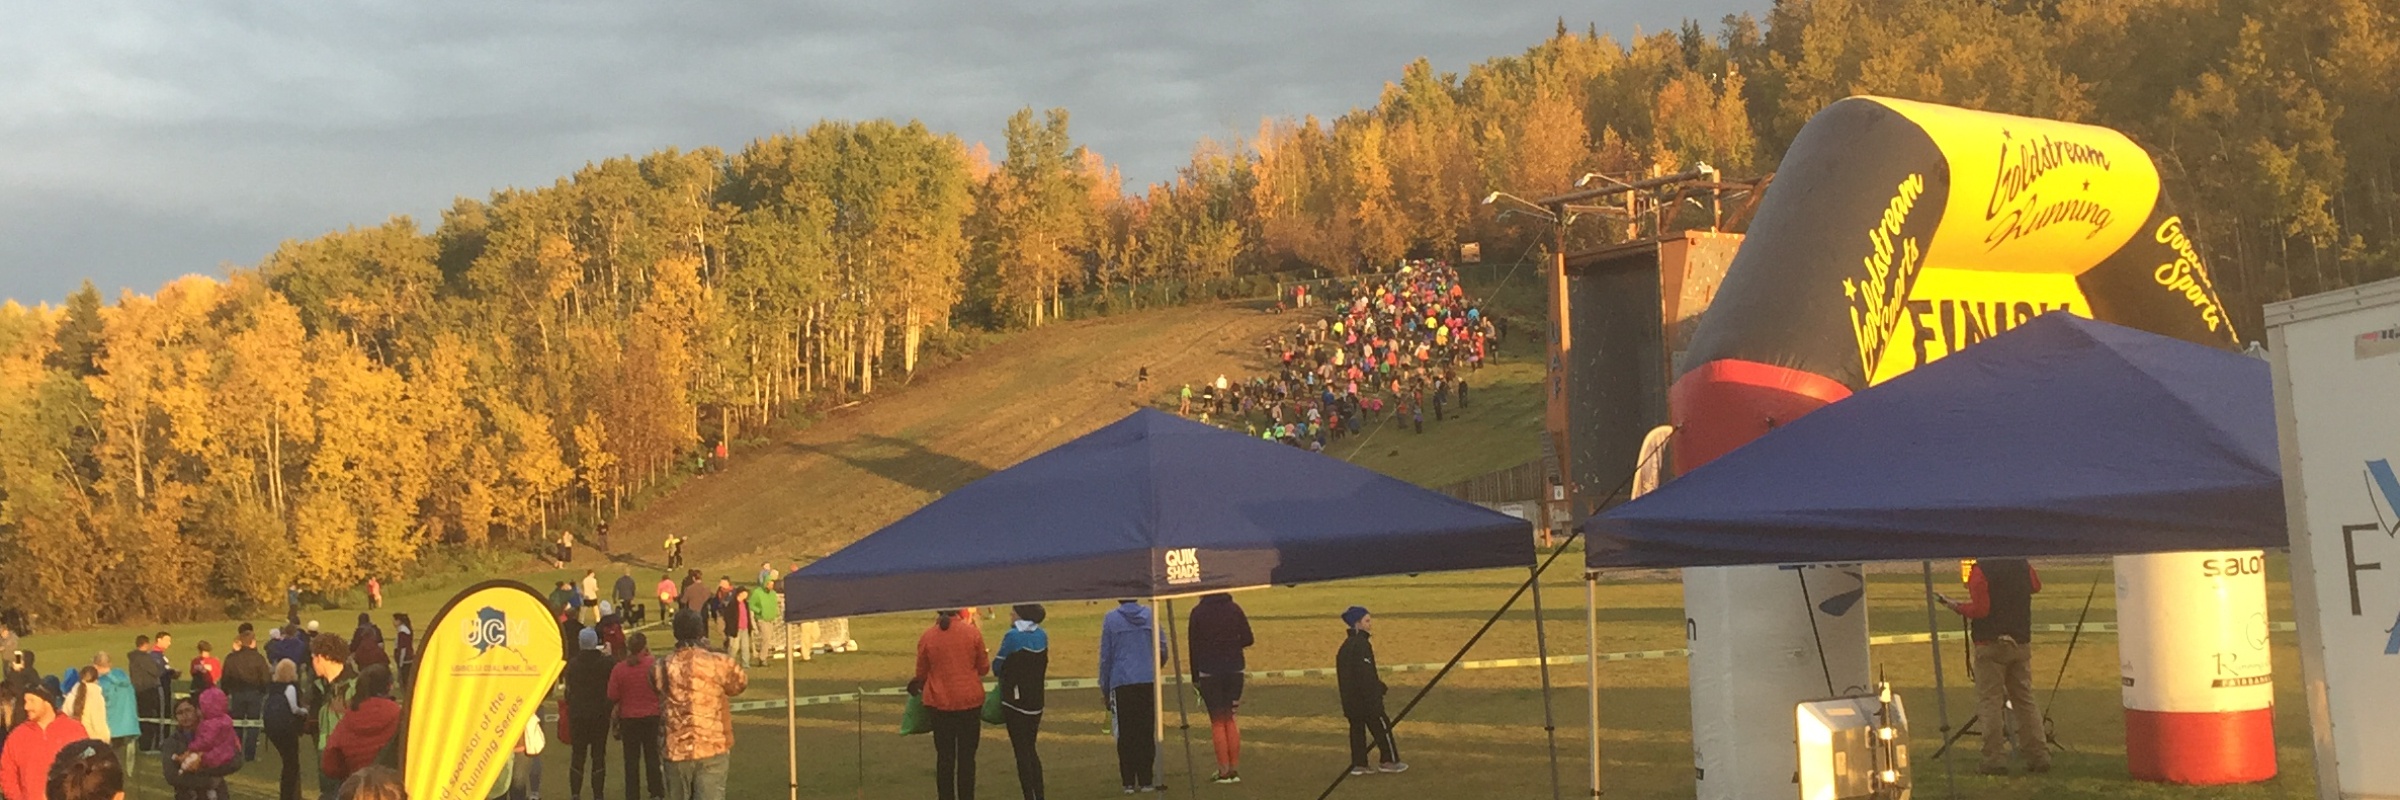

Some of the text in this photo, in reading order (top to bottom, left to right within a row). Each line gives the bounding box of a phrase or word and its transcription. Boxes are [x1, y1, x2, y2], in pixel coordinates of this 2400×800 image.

[1986, 134, 2111, 221] Goldstream
[1984, 193, 2114, 254] Running
[1850, 173, 1924, 382] Goldstream
[2155, 258, 2220, 332] Sports
[1906, 299, 2070, 368] FINI
[1165, 548, 1198, 566] QUIK
[1167, 563, 1200, 580] SHADE
[461, 618, 530, 647] UCM
[449, 731, 482, 788] sponsor
[481, 711, 491, 730] of
[490, 692, 506, 715] the
[460, 695, 524, 797] Running Series
